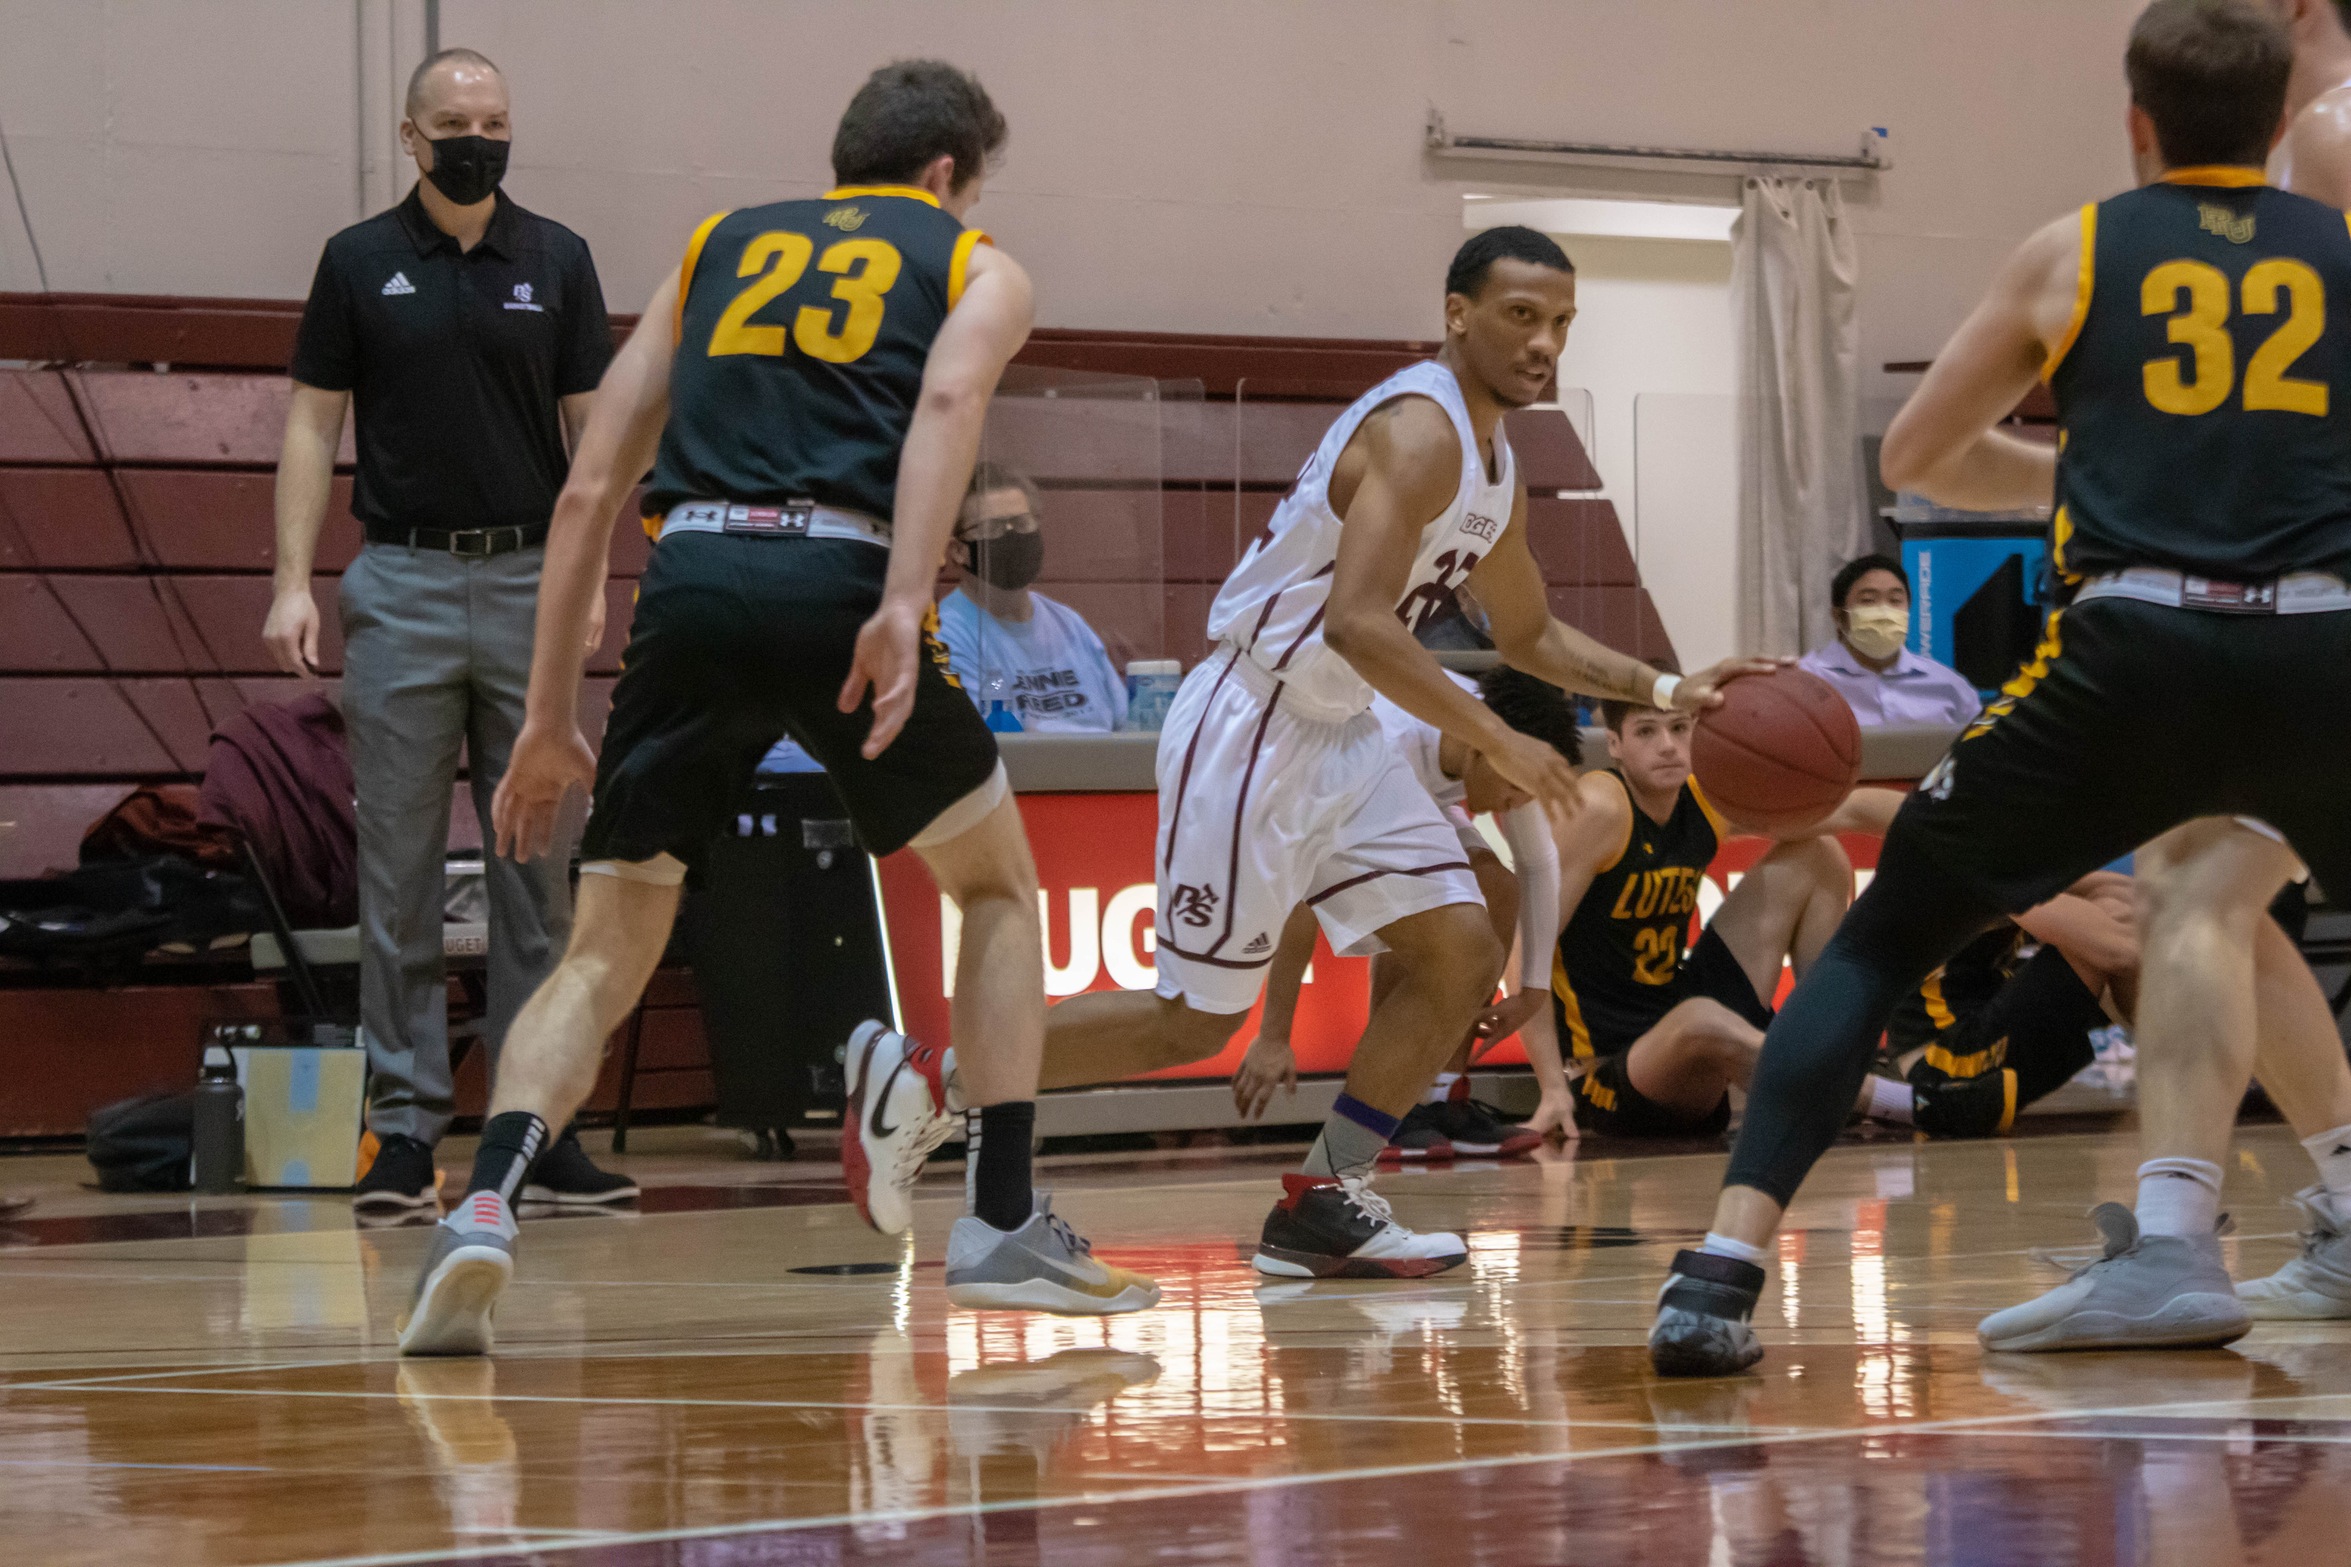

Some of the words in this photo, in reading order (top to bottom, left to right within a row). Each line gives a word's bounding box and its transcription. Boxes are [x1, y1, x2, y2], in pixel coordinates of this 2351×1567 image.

[708, 230, 902, 364] 23
[2140, 257, 2330, 418] 32
[1632, 925, 1679, 986] 22
